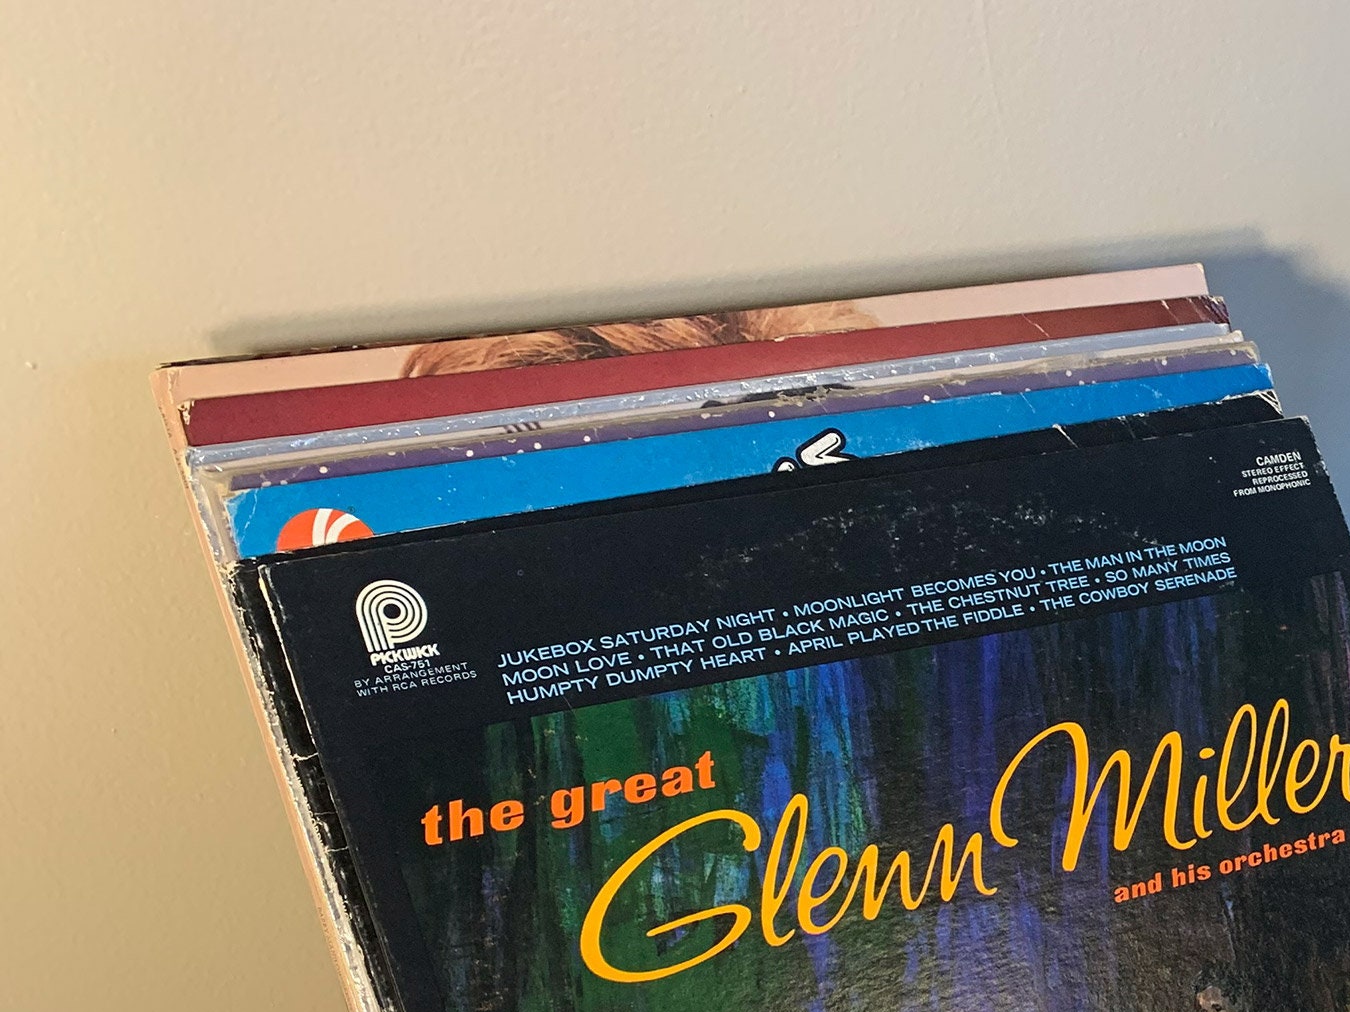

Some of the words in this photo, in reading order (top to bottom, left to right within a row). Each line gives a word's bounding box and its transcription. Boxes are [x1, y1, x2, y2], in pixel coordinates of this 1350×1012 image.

[1241, 467, 1274, 478] STEREO
[1274, 462, 1305, 474] EFFECT
[1256, 451, 1302, 467] CAMDEN
[1233, 486, 1257, 497] FROM
[1257, 478, 1311, 493] MONOPHONIC
[1252, 470, 1308, 486] REPROCESSED
[497, 638, 598, 668] JUKEBOX
[599, 619, 711, 649] SATURDAY
[716, 608, 776, 630] NIGHT
[793, 587, 904, 618] MOONLIGHT
[911, 571, 997, 598] BECOMES
[998, 567, 1037, 583] YOU
[1047, 559, 1084, 575] THE
[1084, 553, 1124, 570] MAN
[1125, 550, 1144, 563] IN
[1143, 544, 1178, 560] THE
[1178, 536, 1227, 554] MOON
[501, 662, 570, 686] MOON
[574, 652, 633, 673] LOVE
[649, 639, 706, 660] THAT
[711, 632, 753, 650] OLD
[757, 619, 825, 642] BLACK
[828, 608, 890, 630] MAGIC
[906, 599, 945, 616] THE
[947, 583, 1042, 609] CHESTNUT
[1045, 575, 1091, 594] TREE
[1104, 569, 1129, 583] SO
[1132, 560, 1179, 580] MANY
[1182, 552, 1232, 570] TIMES
[506, 675, 599, 705] HUMPTY
[605, 659, 694, 687] DUMPTY
[699, 647, 767, 670] HEART
[788, 635, 844, 656] APRIL
[847, 622, 921, 645] PLAYED
[920, 615, 960, 632] THE
[962, 603, 1025, 626] FIDDLE
[1039, 595, 1076, 611] THE
[1078, 581, 1150, 605] COWBOY
[1154, 566, 1238, 592] SERENADE
[370, 643, 440, 666] PICKWICK
[384, 659, 431, 674] CAS-751
[354, 678, 370, 688] BY
[375, 662, 468, 685] ARRANGEMENT
[356, 685, 389, 697] WITH
[392, 681, 418, 692] RCA
[421, 670, 478, 687] RECORDS
[421, 796, 526, 847] the
[550, 749, 718, 830] great
[1113, 872, 1164, 903] and
[1170, 863, 1213, 888] his
[1218, 828, 1347, 875] orchestra
[579, 792, 997, 984] Glenn
